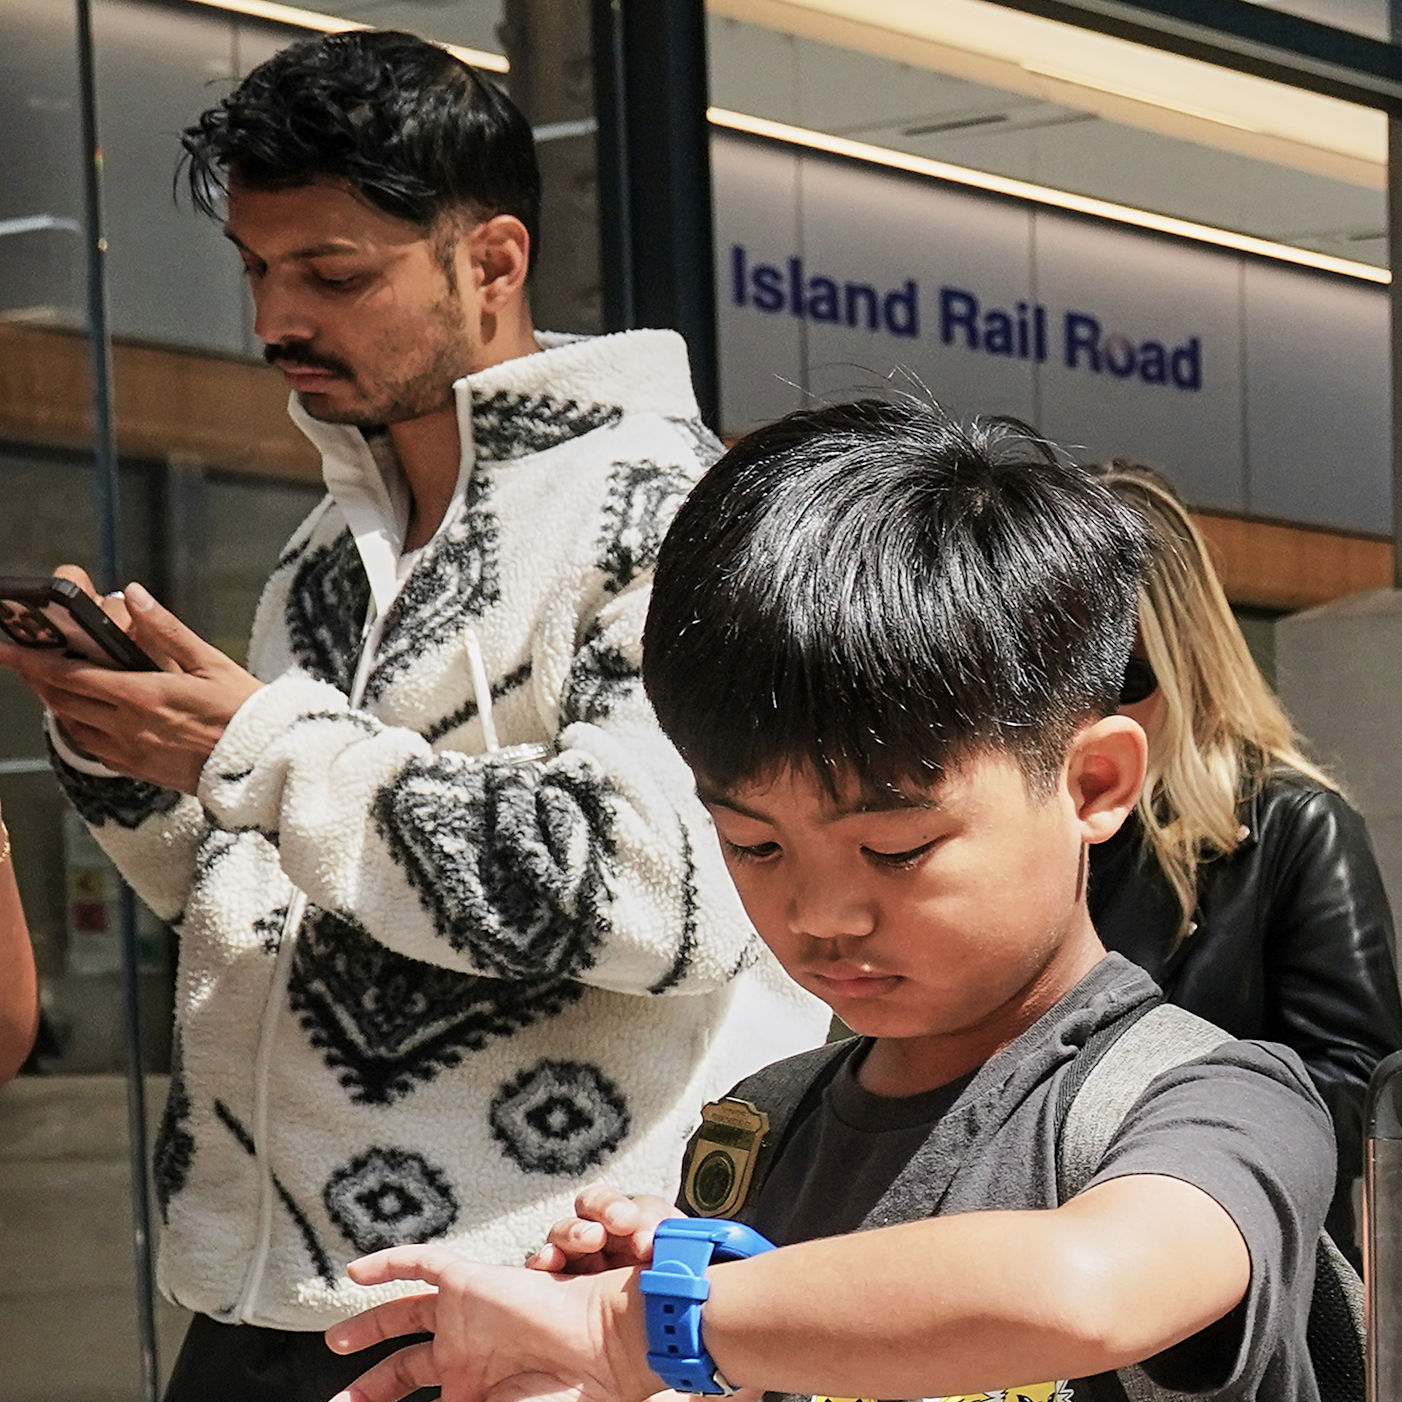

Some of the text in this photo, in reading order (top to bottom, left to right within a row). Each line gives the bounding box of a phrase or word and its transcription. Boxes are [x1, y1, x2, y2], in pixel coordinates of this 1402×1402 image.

[729, 243, 1203, 392] Island Rail Road
